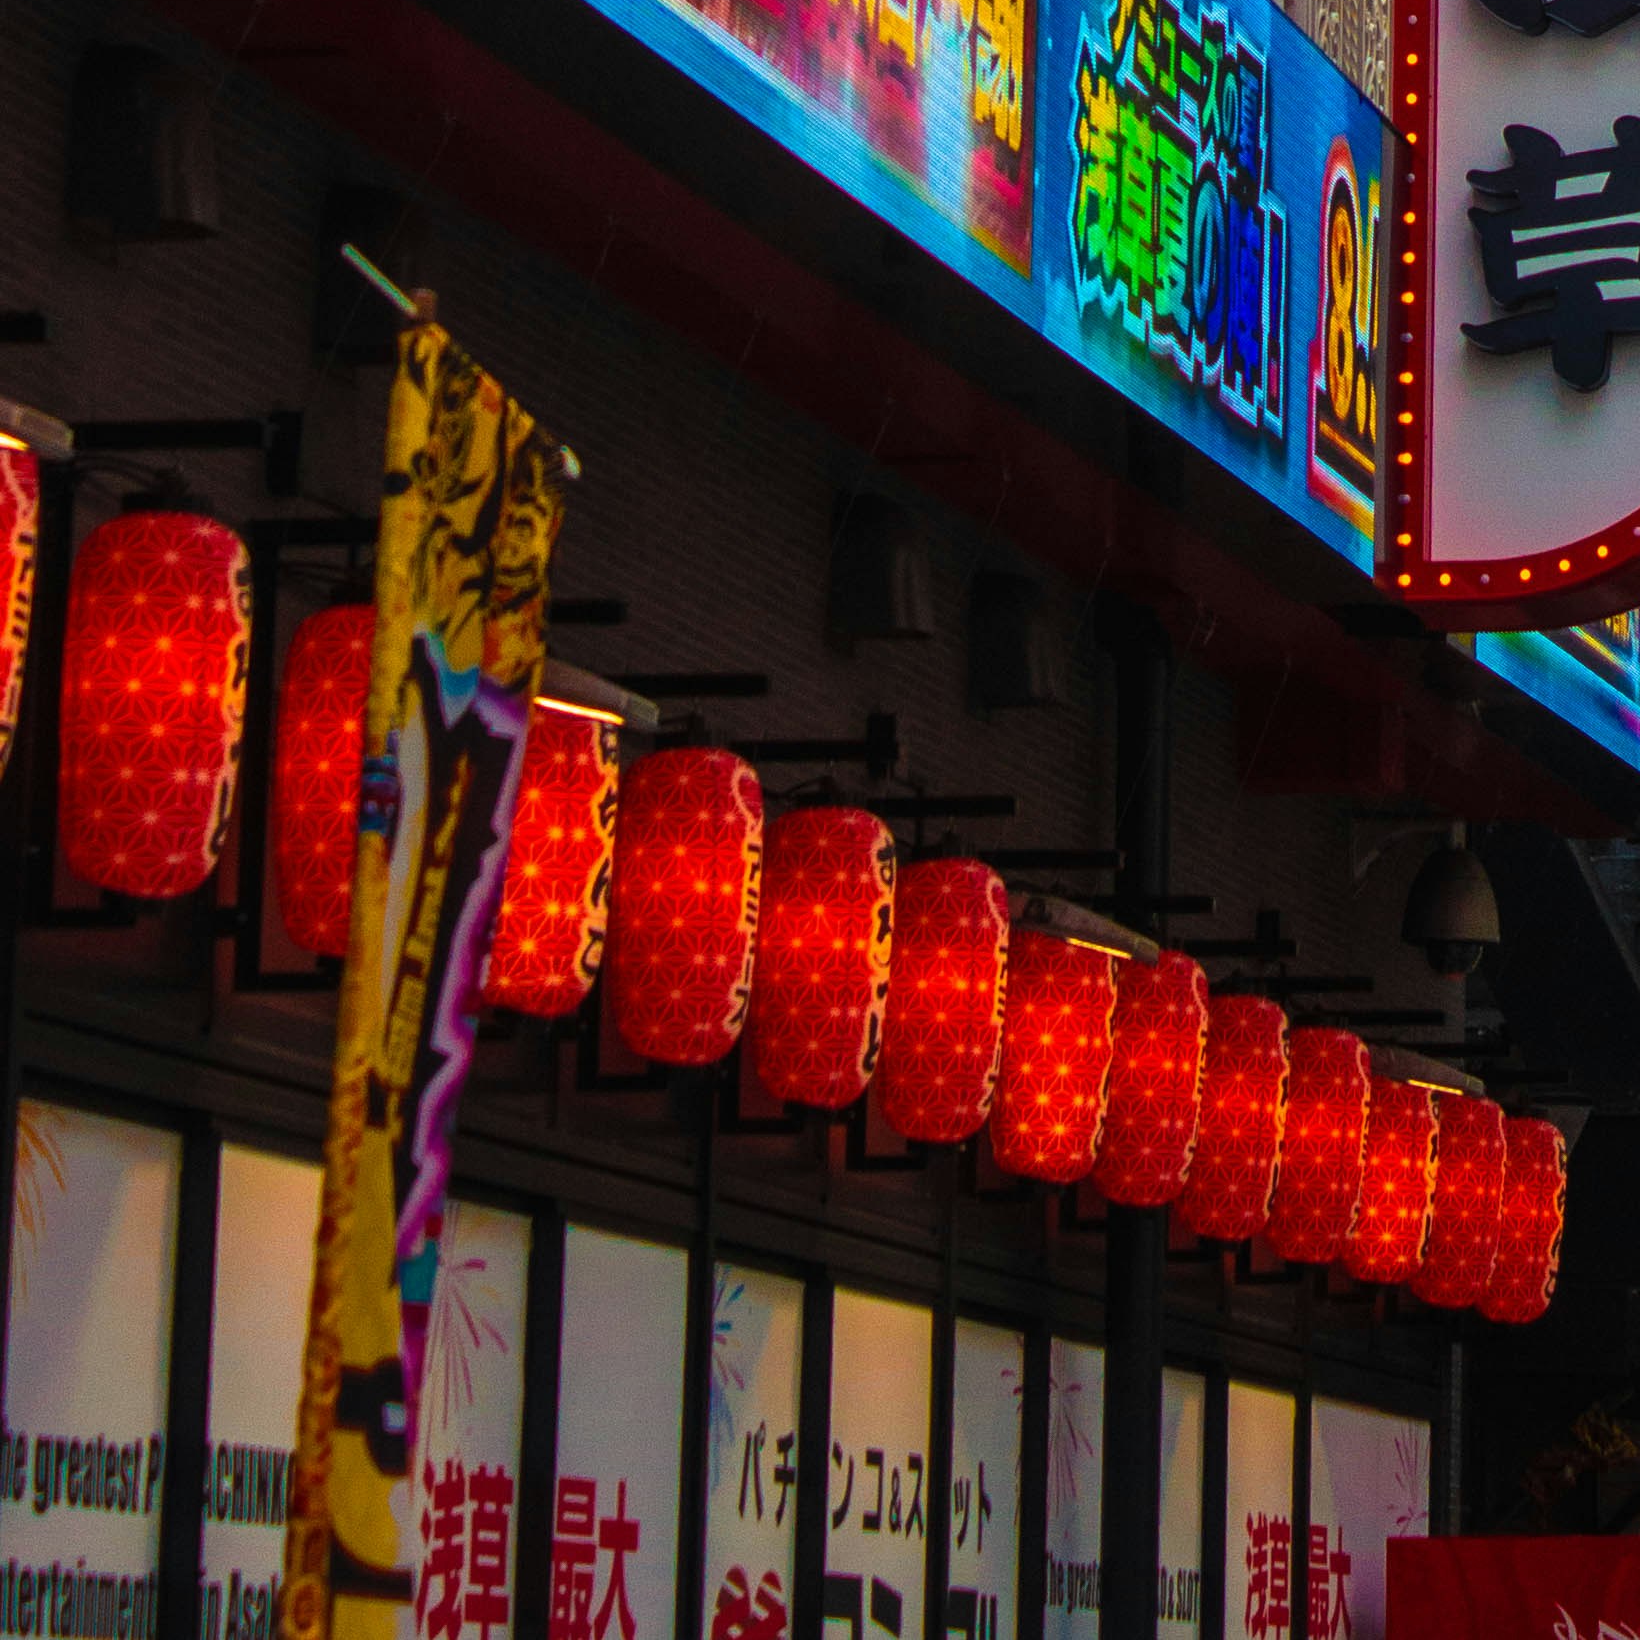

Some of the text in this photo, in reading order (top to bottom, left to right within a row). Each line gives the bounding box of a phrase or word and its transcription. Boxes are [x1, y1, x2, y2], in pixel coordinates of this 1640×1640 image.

[31, 1432, 144, 1515] greatest
[737, 1419, 993, 1555] パチンコ&スット
